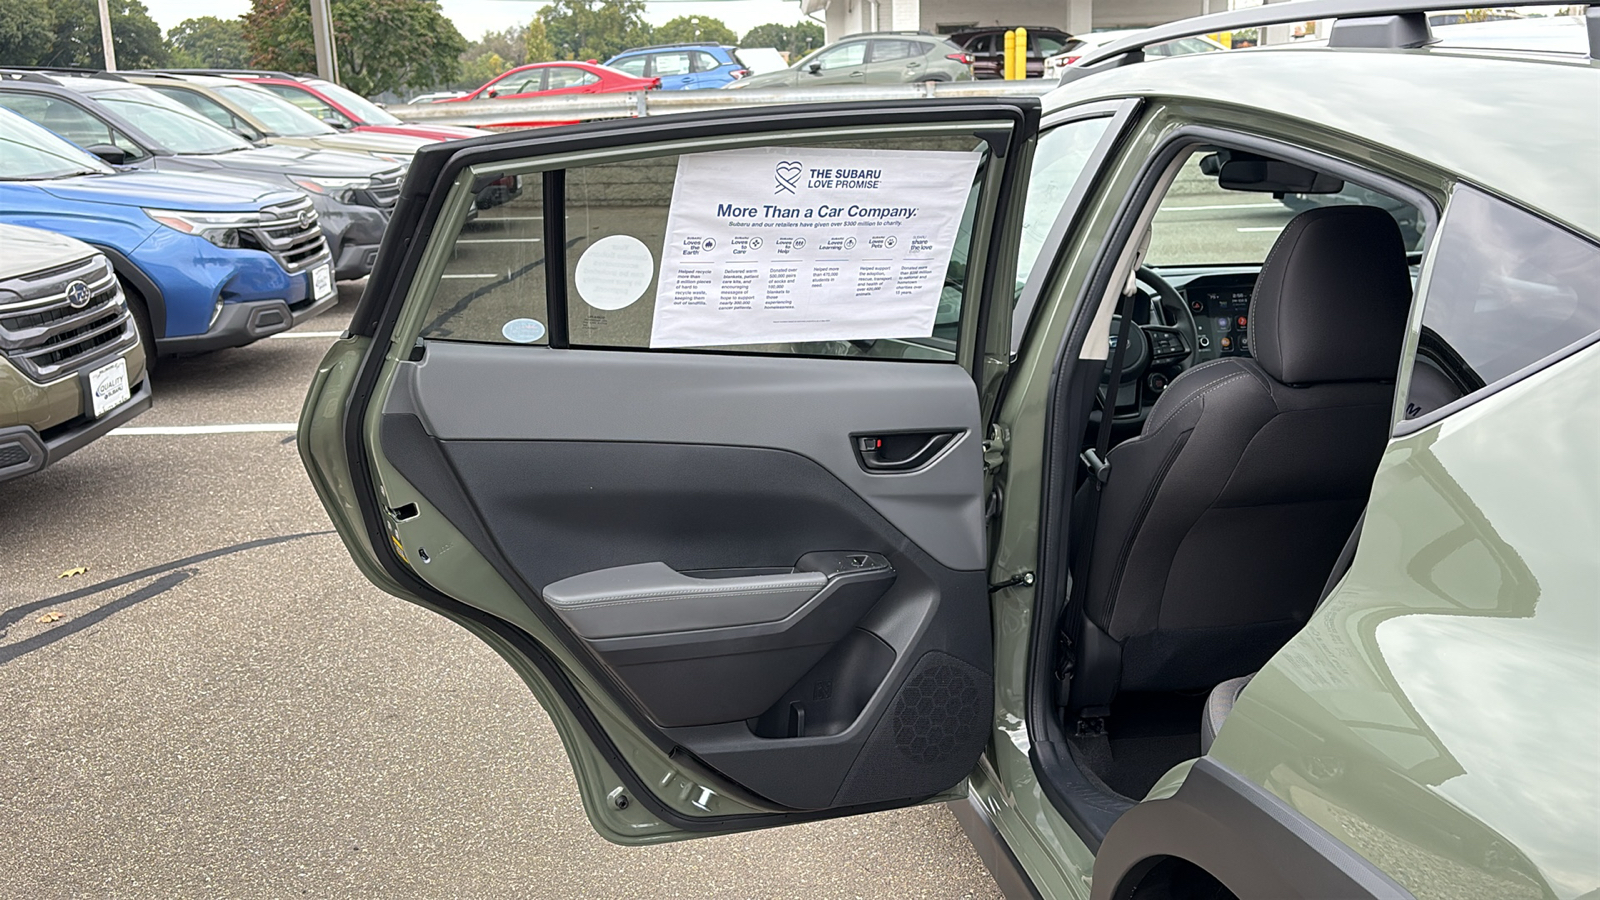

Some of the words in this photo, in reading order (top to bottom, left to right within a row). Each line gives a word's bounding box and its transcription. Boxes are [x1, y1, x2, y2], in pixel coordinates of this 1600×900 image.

[810, 169, 832, 178] THE
[835, 169, 882, 179] SUBARU
[808, 180, 833, 188] LOVE
[717, 204, 758, 218] More
[763, 205, 800, 218] Than
[804, 208, 813, 218] a
[818, 205, 845, 218] Car
[100, 375, 123, 393] QUALITY
